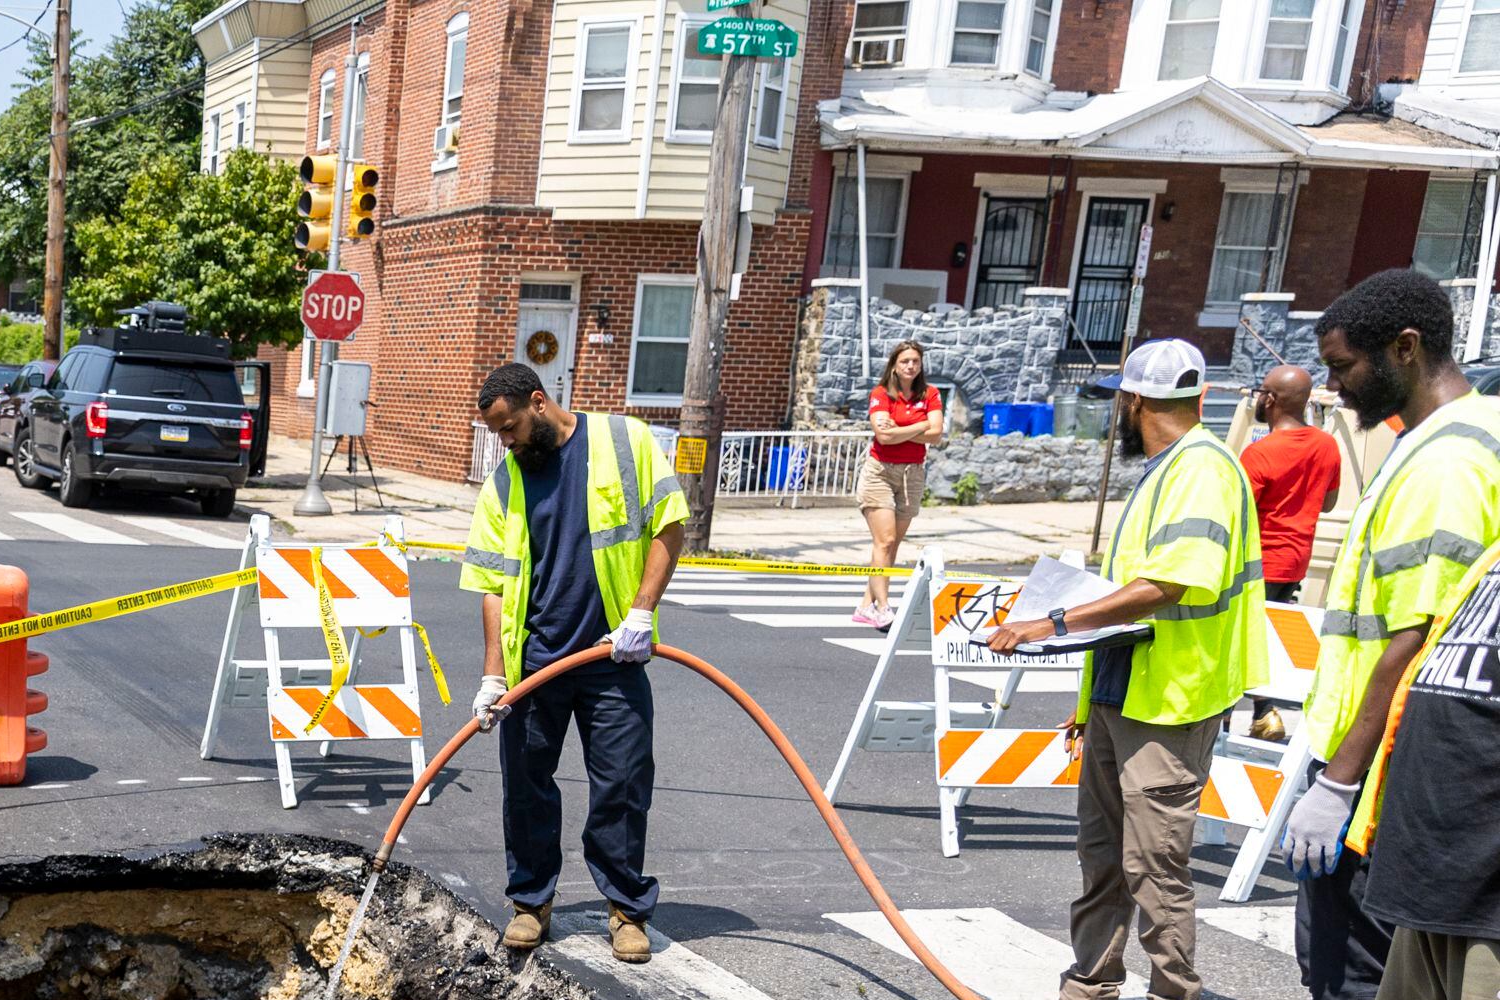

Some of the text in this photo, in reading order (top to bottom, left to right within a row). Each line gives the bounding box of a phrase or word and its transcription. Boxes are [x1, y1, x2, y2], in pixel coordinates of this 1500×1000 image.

[744, 21, 754, 31] N
[756, 23, 776, 31] 1500
[722, 33, 794, 56] 57TH ST
[306, 292, 361, 320] STOP
[327, 628, 340, 642] NOT
[330, 642, 346, 664] ENTER
